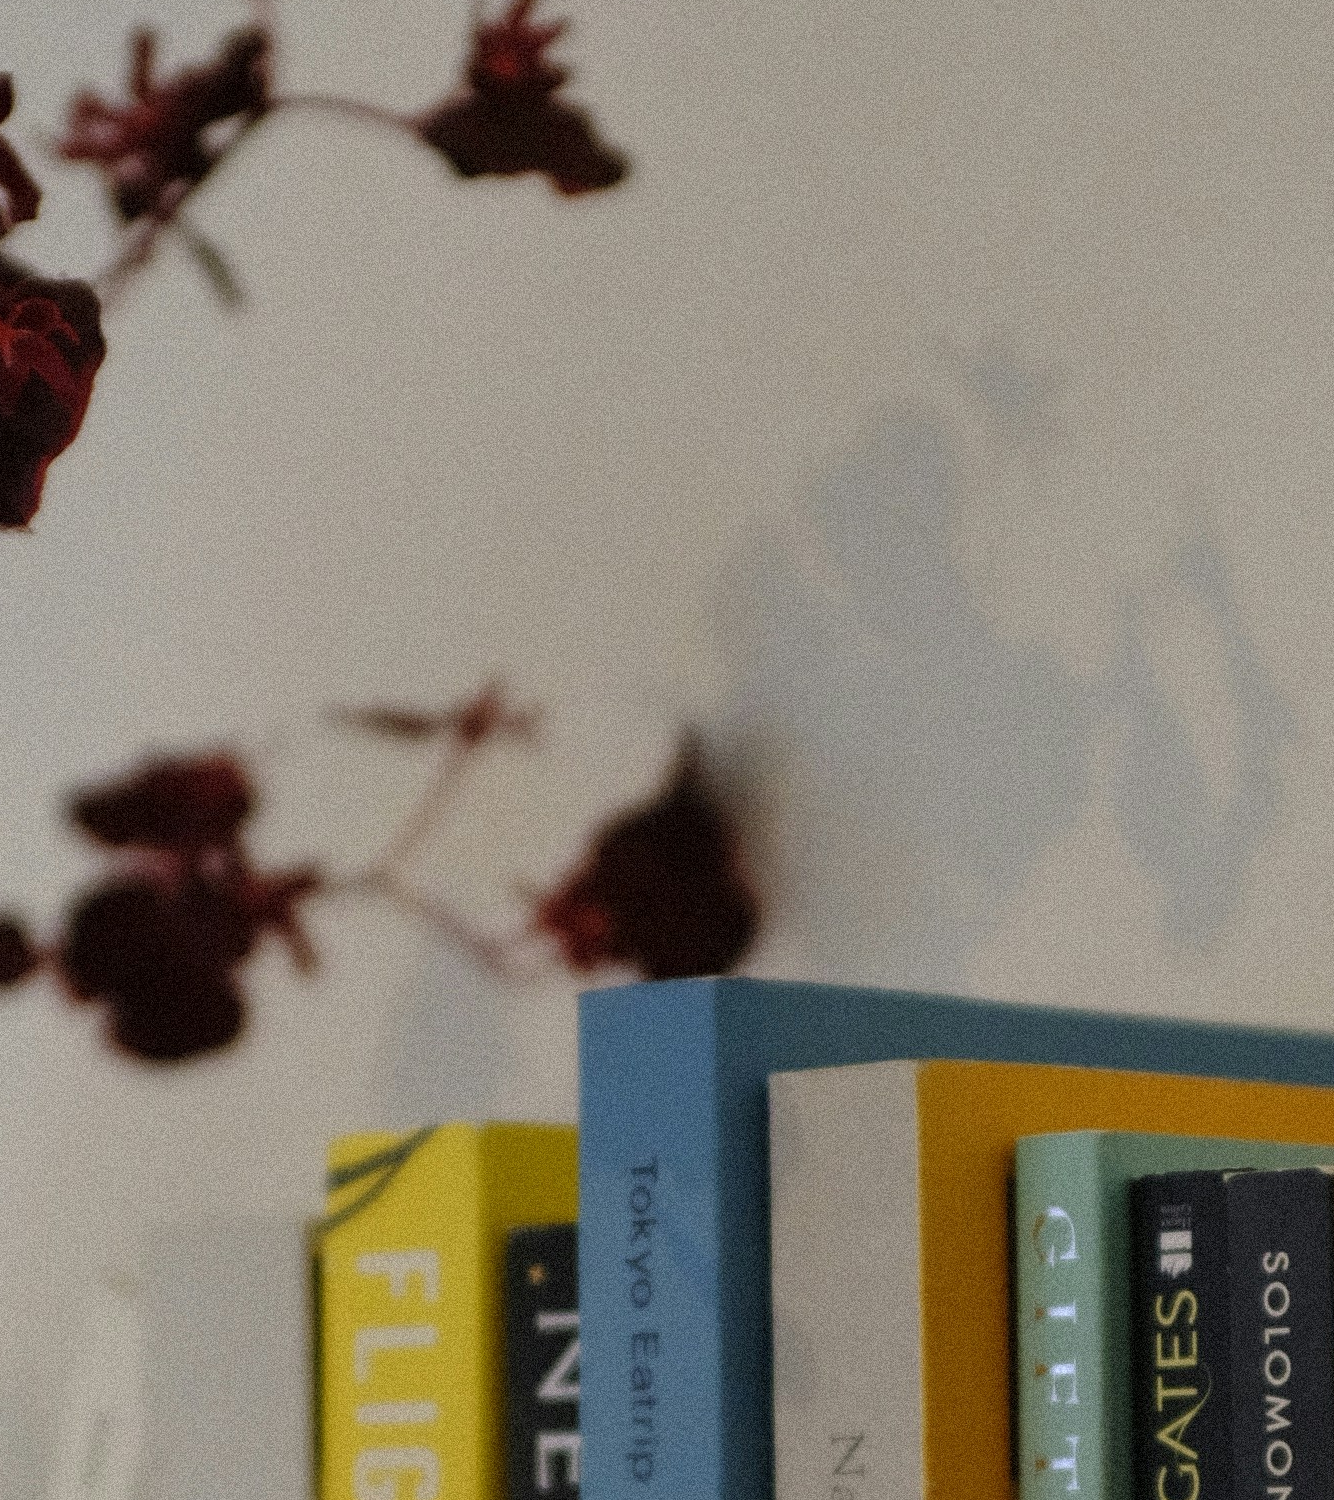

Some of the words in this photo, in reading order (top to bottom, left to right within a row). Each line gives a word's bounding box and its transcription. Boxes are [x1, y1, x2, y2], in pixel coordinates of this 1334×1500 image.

[624, 1157, 661, 1309] Tokyo
[625, 1329, 661, 1485] Eatrip
[1032, 1205, 1081, 1494] GIFT
